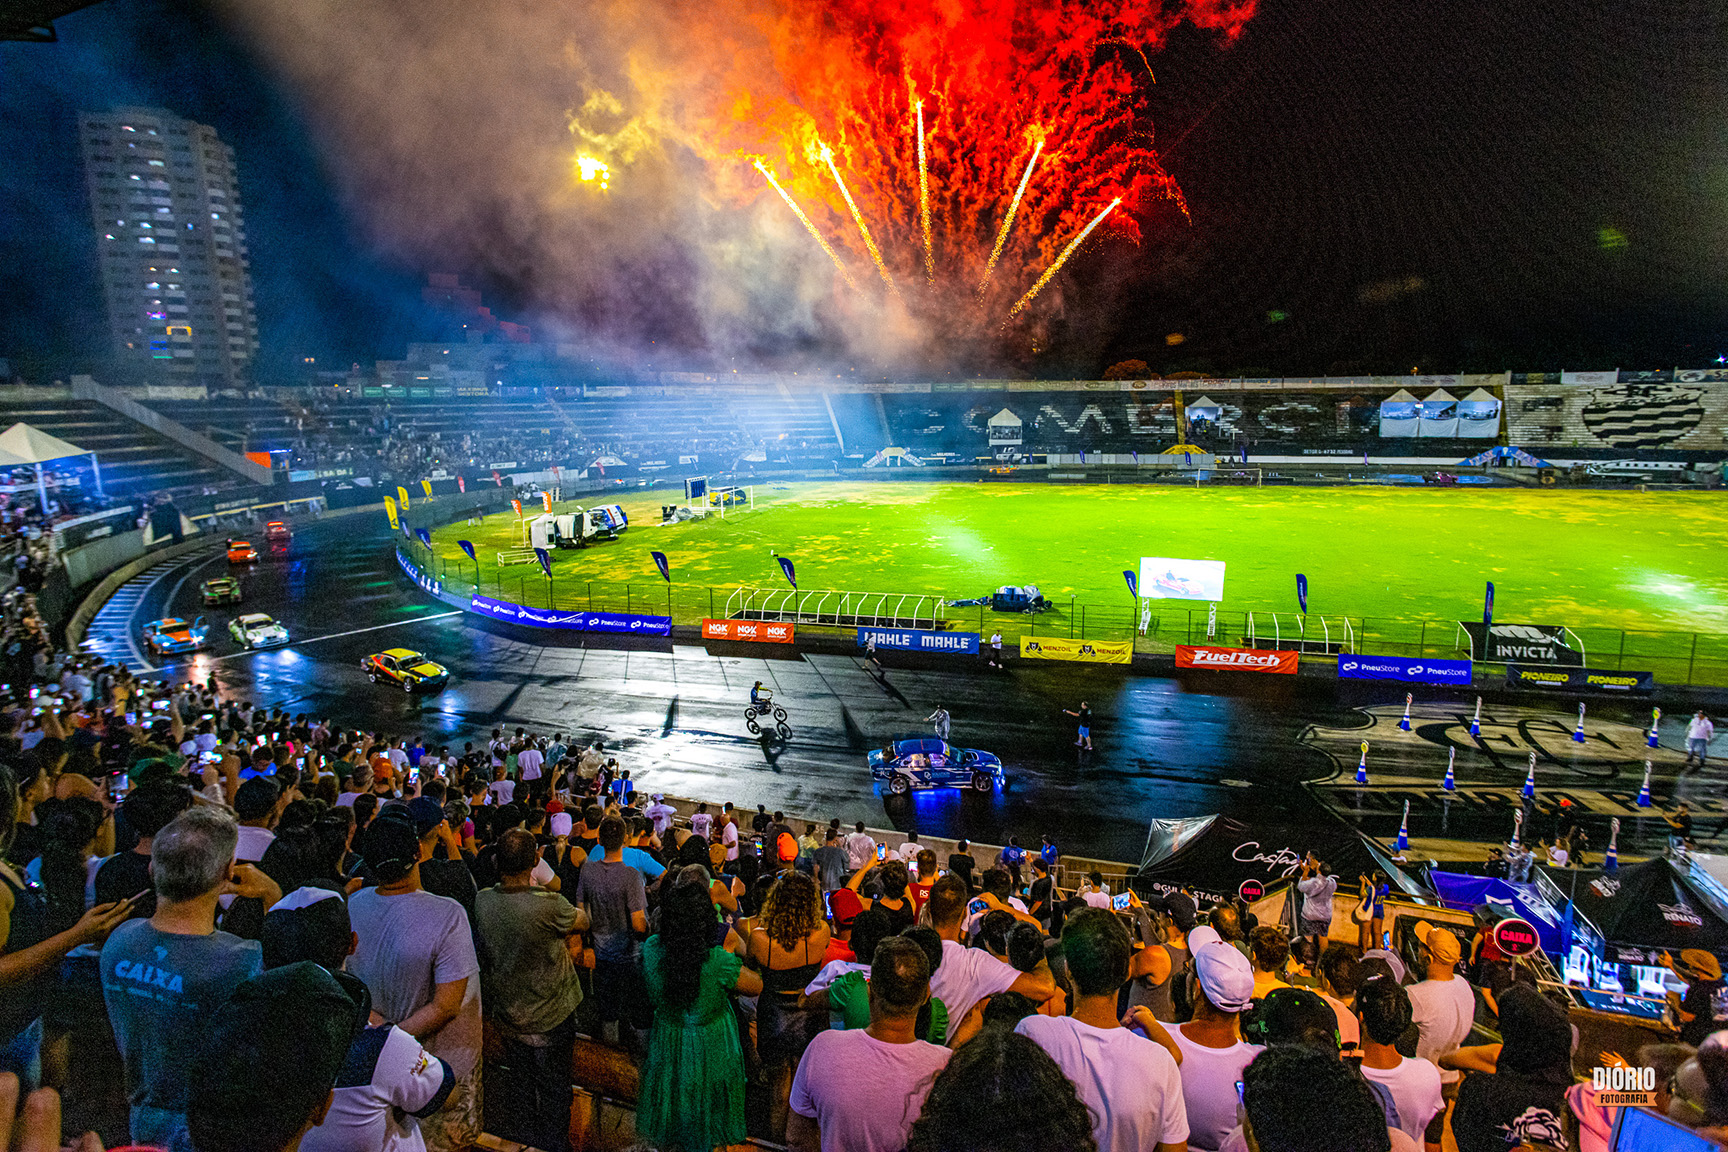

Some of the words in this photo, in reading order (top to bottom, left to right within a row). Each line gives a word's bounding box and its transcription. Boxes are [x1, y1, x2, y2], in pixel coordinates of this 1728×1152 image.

[708, 623, 728, 632] NGK
[737, 625, 757, 634] NGK
[767, 627, 787, 636] NGK
[921, 635, 969, 649] MAHLE
[1043, 645, 1072, 653] MENZOIL
[1496, 645, 1558, 660] INVICTA
[1192, 650, 1280, 666] FuelTech
[1361, 664, 1400, 673] PneuStore
[1427, 667, 1467, 676] PneuStore
[1521, 671, 1569, 682] PIONEIRO
[1587, 675, 1638, 686] PIONEIRO
[1663, 912, 1702, 926] RENATO
[1500, 929, 1533, 945] CAIXA
[115, 960, 184, 994] CAIXA
